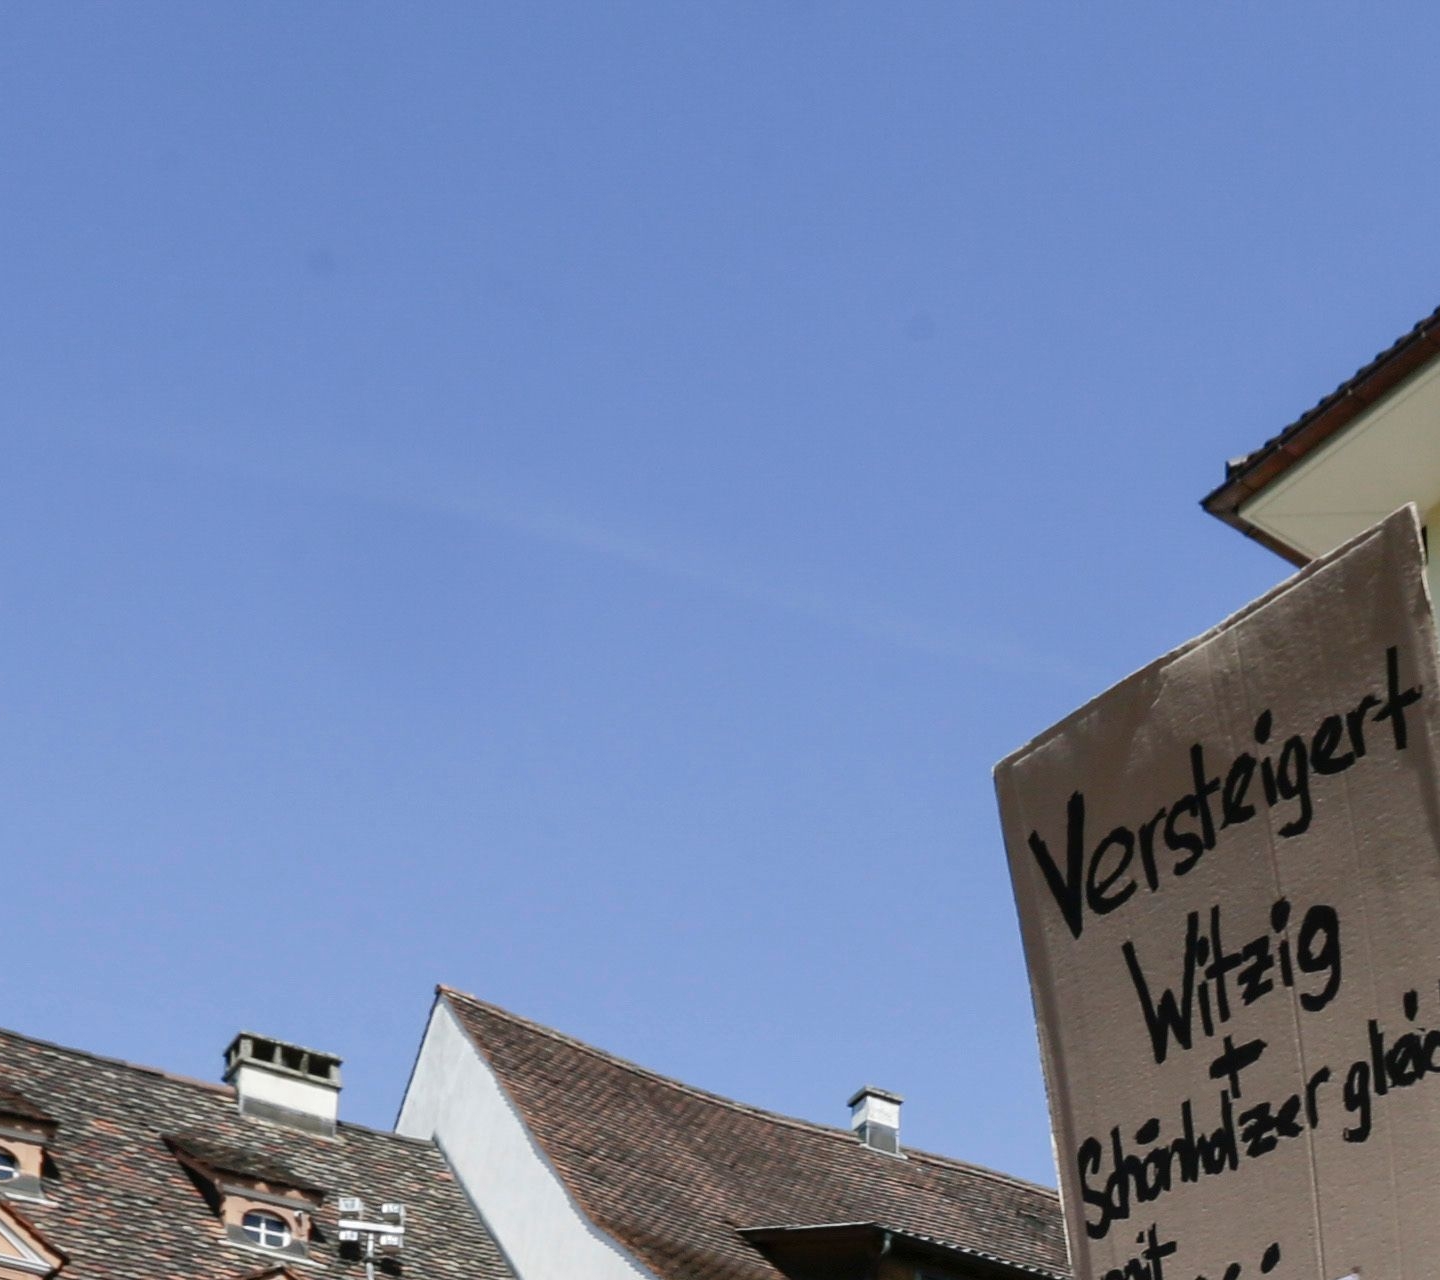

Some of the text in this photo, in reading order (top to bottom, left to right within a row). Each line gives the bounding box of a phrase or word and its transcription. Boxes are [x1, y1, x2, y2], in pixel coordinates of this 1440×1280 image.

[1029, 646, 1424, 939] Versteigert
[1122, 896, 1343, 1064] Witzig
[1209, 1035, 1268, 1098] +
